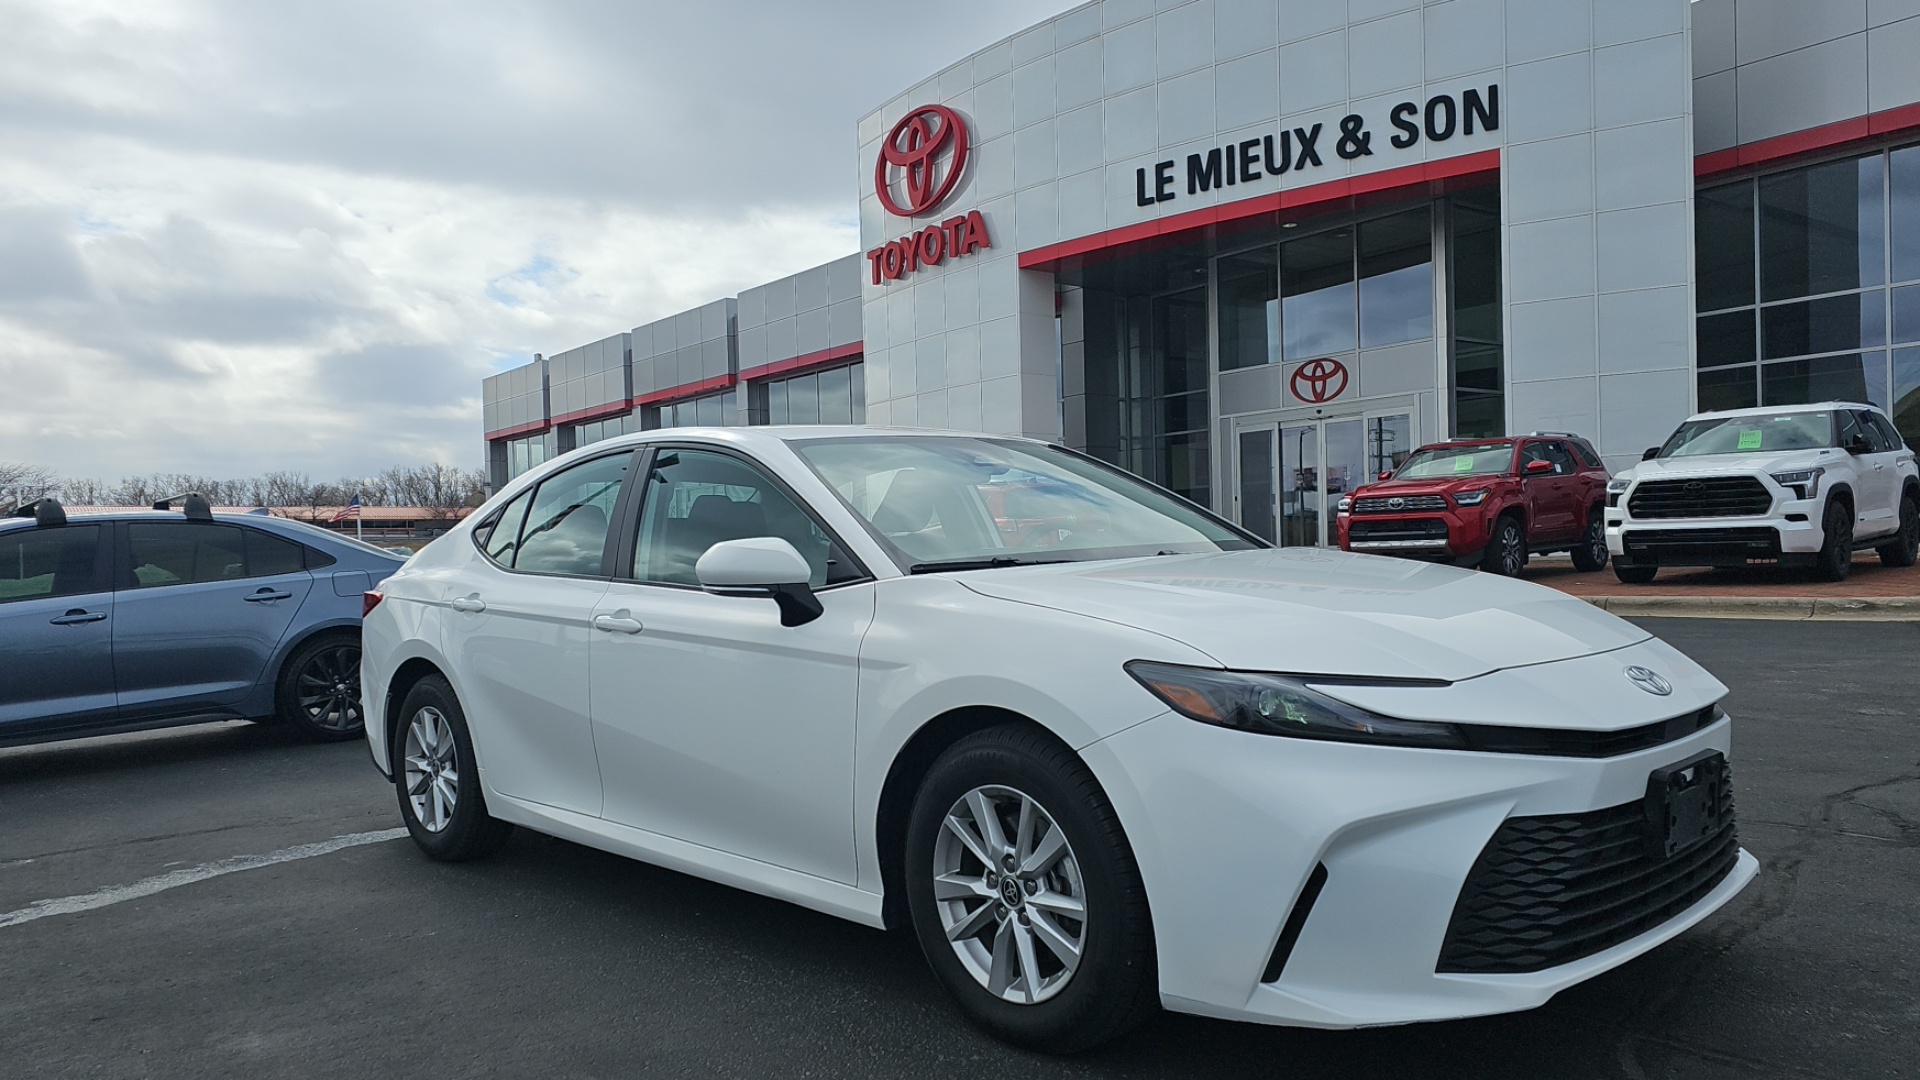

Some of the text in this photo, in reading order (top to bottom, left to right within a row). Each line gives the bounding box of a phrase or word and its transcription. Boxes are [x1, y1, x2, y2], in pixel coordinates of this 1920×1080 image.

[1136, 83, 1500, 207] LE MIEUX & SON
[867, 209, 992, 286] TOYOTA
